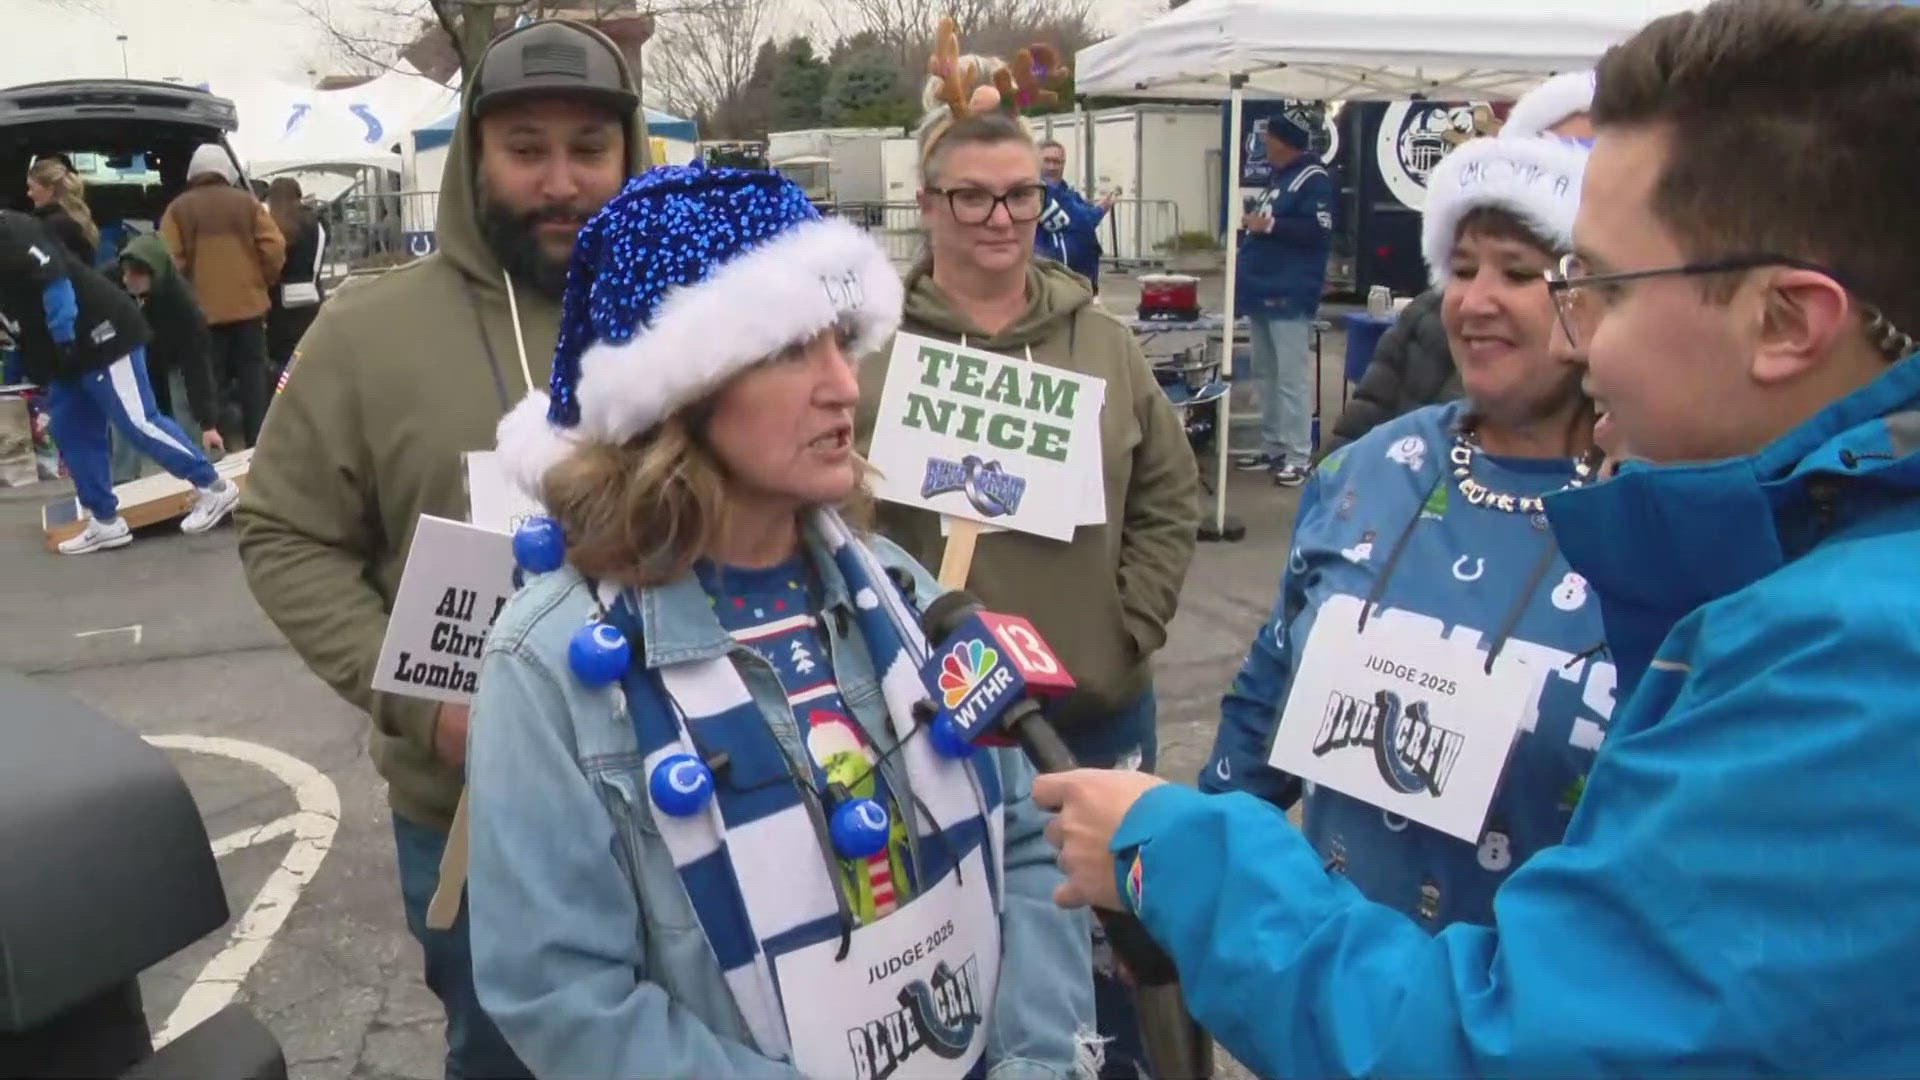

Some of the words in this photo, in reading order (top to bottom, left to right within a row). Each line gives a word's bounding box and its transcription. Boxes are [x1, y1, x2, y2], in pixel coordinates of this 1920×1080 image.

[918, 345, 1080, 419] TEAM
[901, 392, 1071, 463] NICE
[435, 587, 478, 622] All
[430, 621, 487, 660] Chri
[996, 624, 1058, 674] 13
[394, 652, 480, 695] Lomba
[954, 666, 1014, 730] WTHR
[1364, 653, 1417, 683] JUDGE
[1418, 671, 1458, 696] 2025
[1313, 690, 1379, 757] BLUE
[1396, 716, 1466, 798] CREW
[868, 942, 925, 985] JUDGE
[926, 919, 955, 954] 2025
[847, 1007, 925, 1080] BLUE
